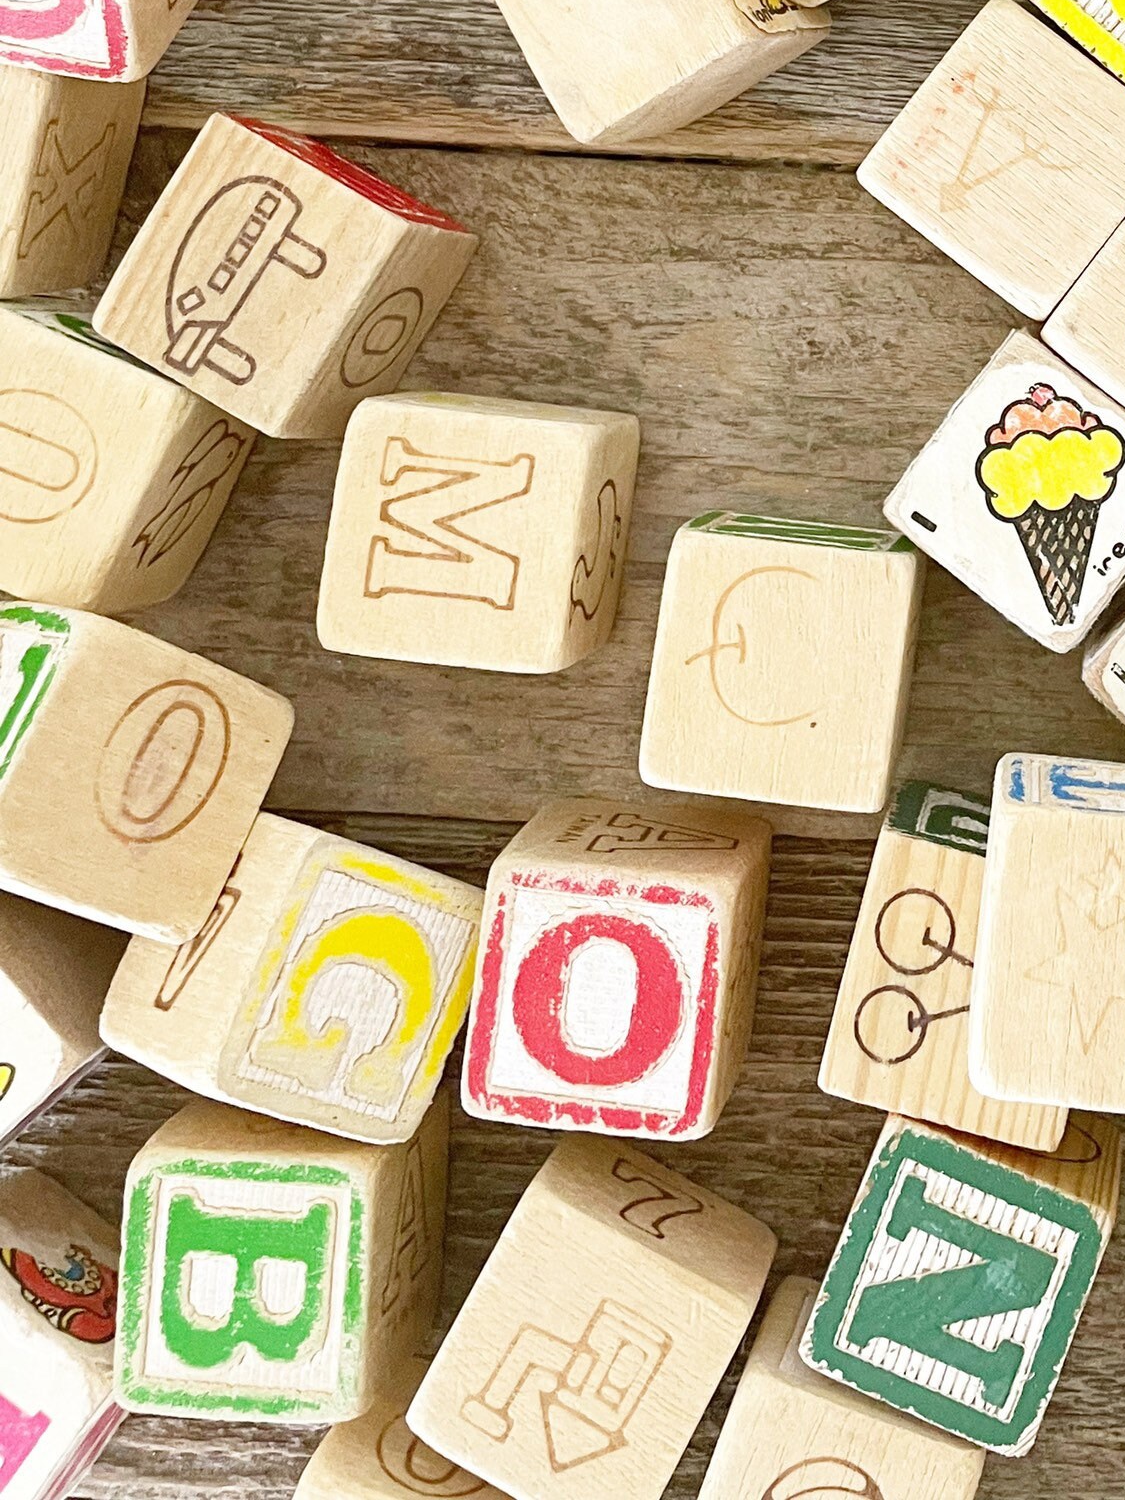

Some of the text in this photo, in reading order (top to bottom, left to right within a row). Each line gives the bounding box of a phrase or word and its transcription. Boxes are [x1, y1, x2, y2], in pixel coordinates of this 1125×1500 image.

[363, 435, 536, 611] M
[161, 1192, 331, 1369] B
[611, 1156, 704, 1240] 7
[844, 1173, 1060, 1404] N
